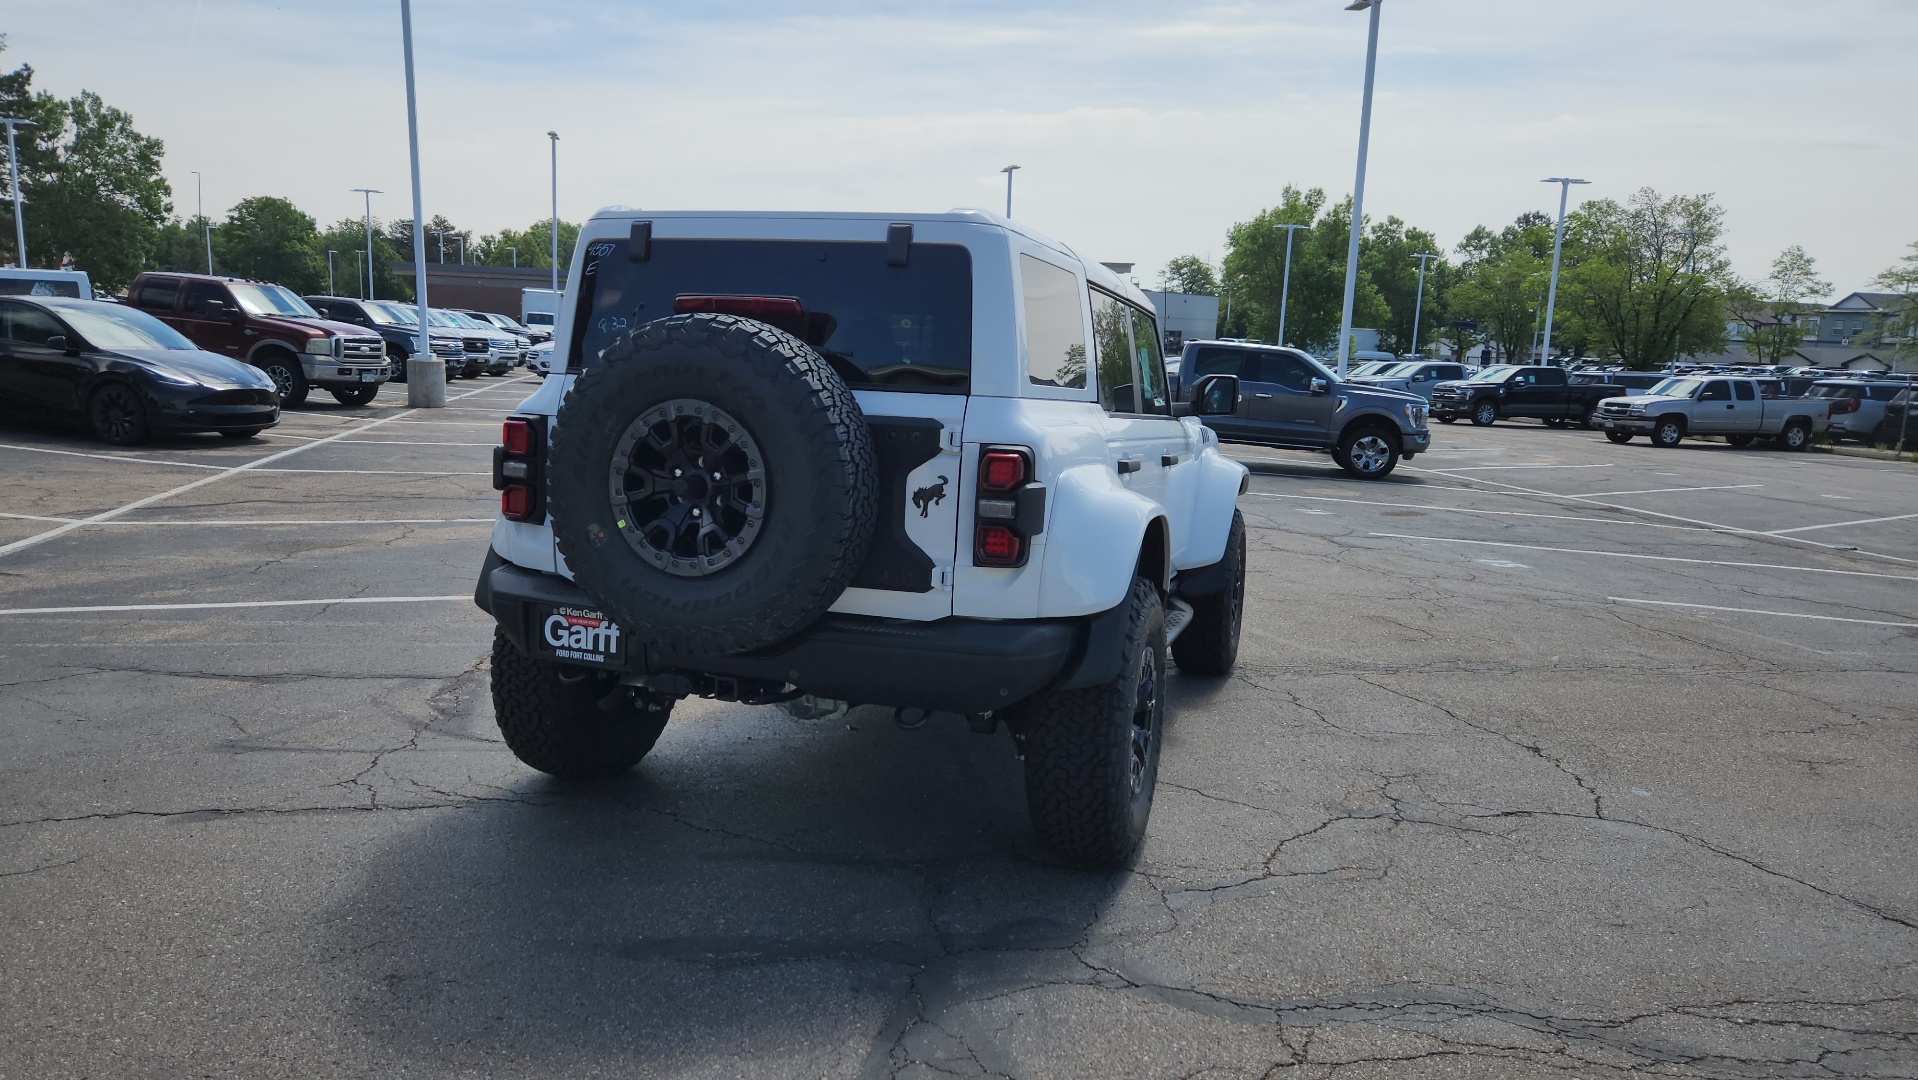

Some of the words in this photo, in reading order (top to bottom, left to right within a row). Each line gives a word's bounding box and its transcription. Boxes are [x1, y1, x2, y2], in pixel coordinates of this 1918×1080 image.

[587, 242, 616, 257] 4557
[544, 614, 620, 654] Garff
[555, 649, 569, 658] FORD
[570, 650, 583, 660] FORT
[583, 652, 605, 663] COLLINS
